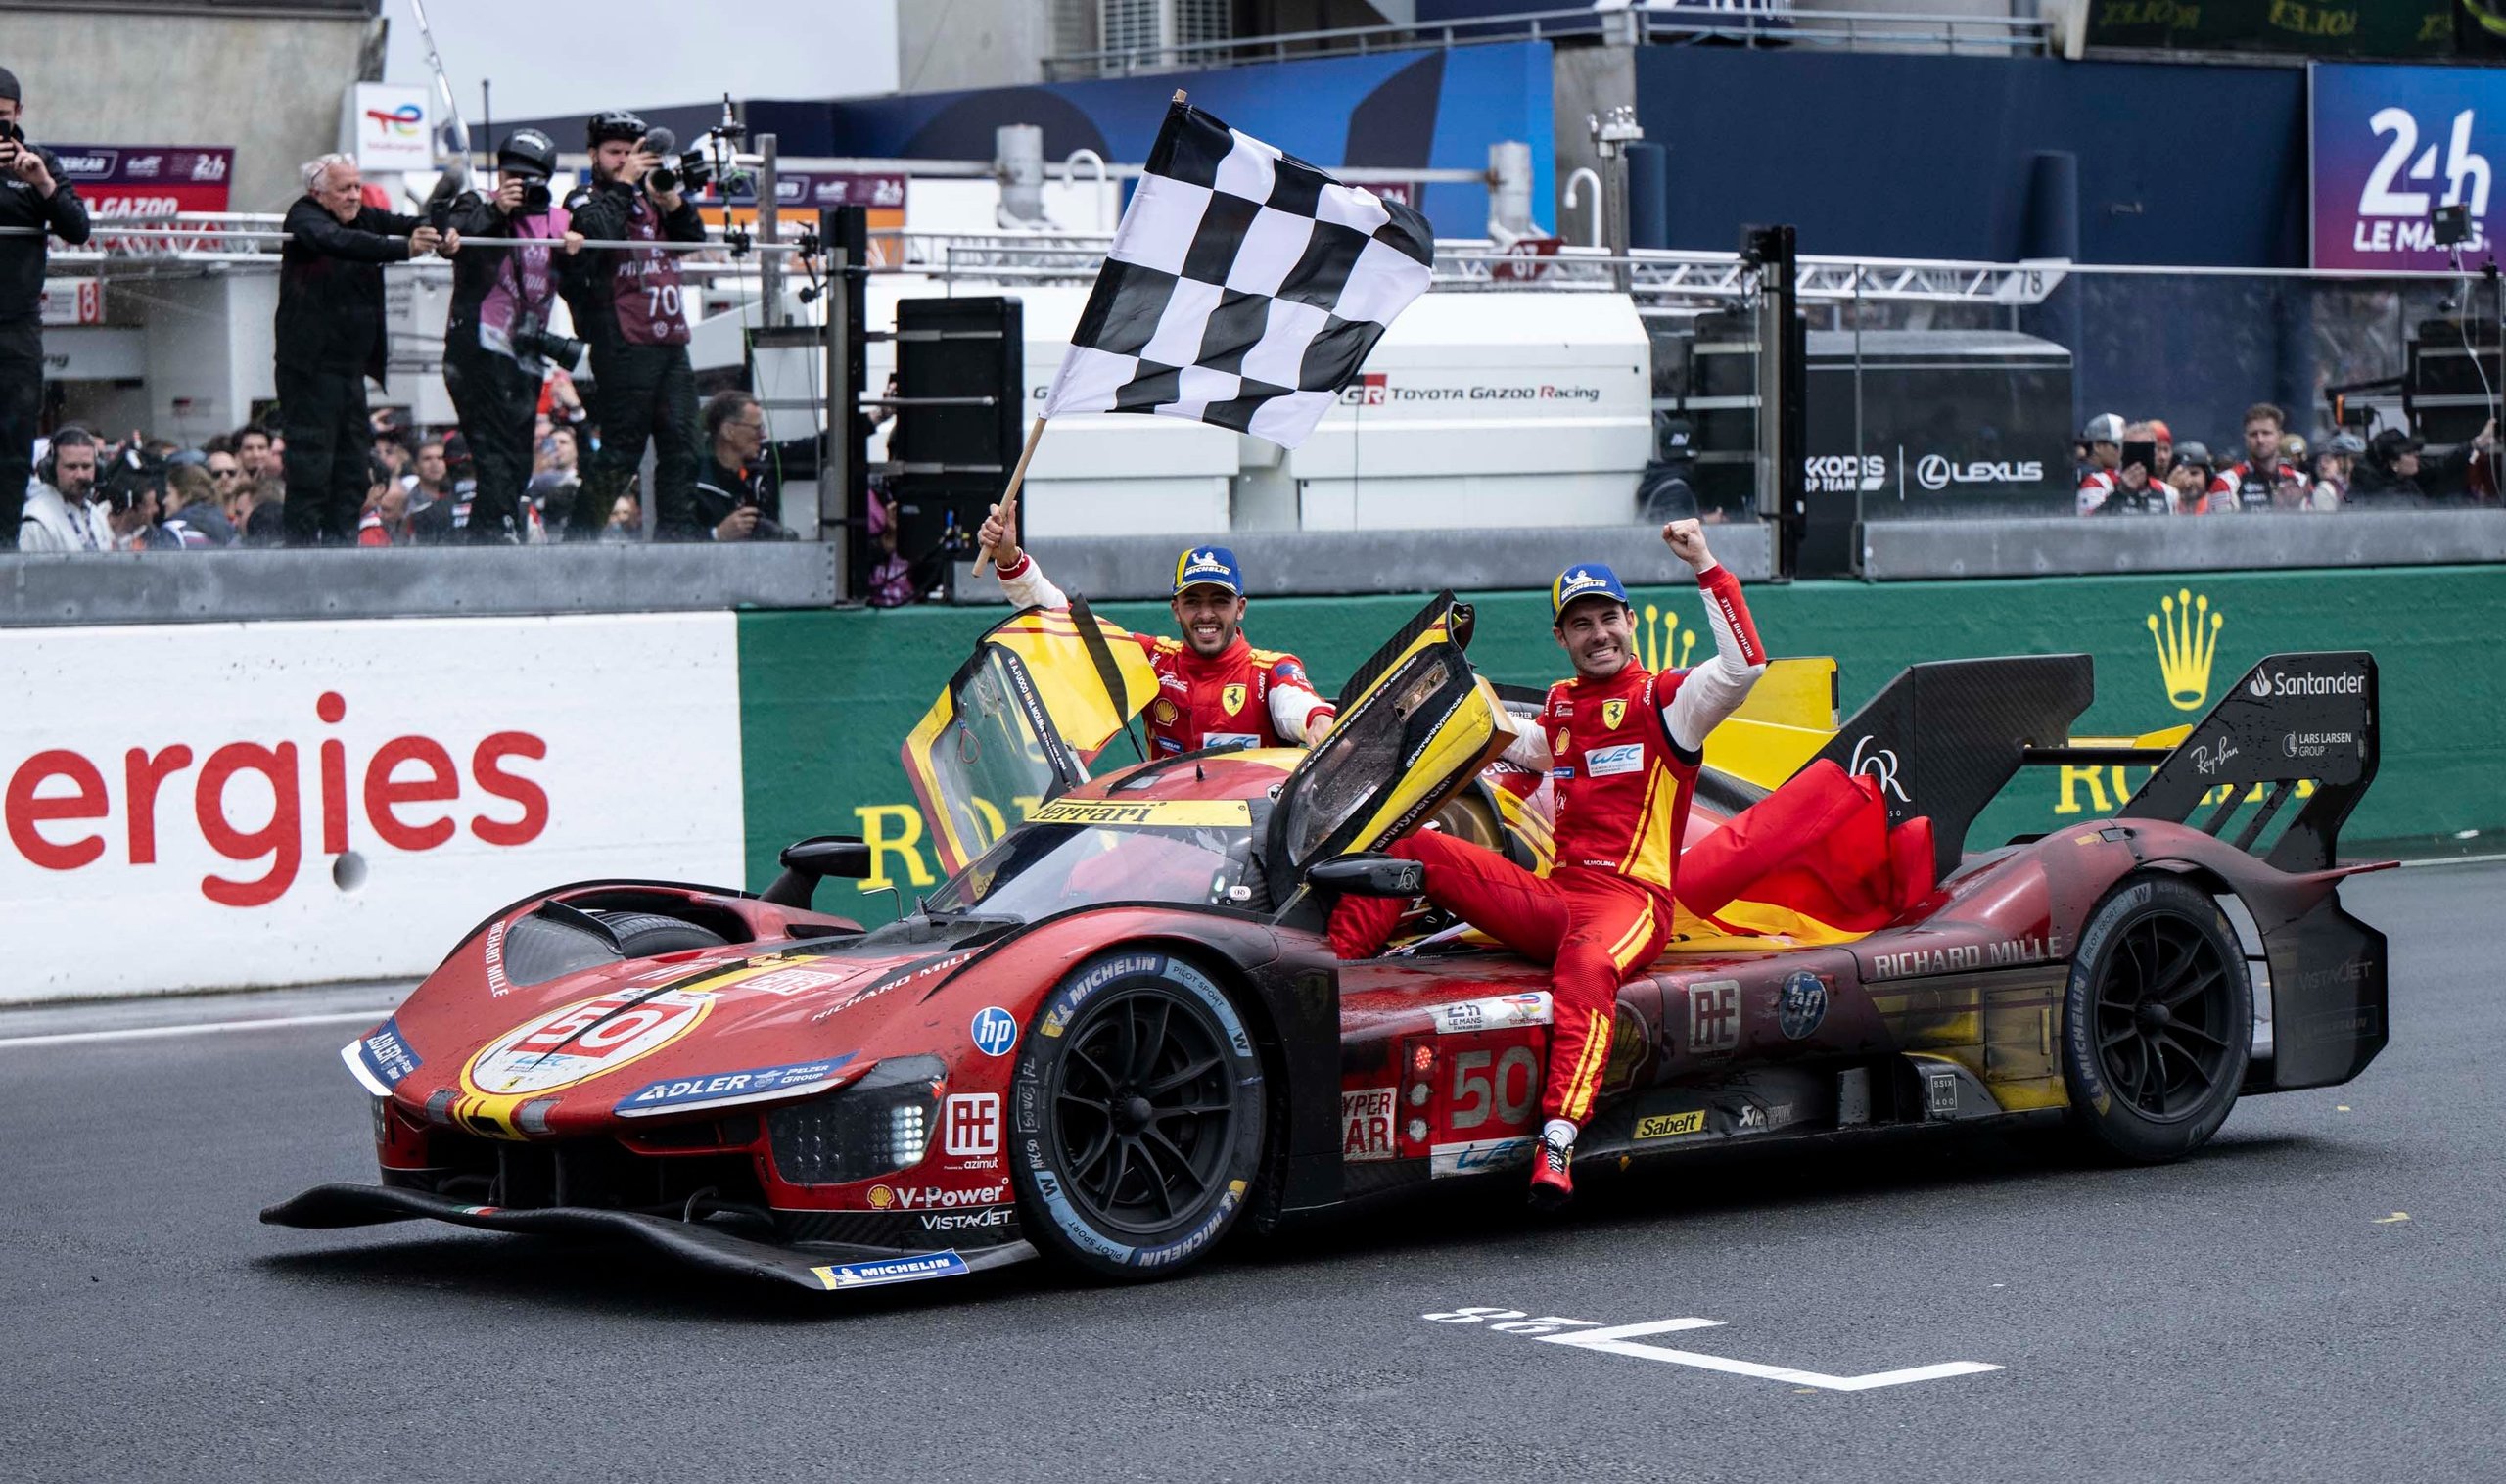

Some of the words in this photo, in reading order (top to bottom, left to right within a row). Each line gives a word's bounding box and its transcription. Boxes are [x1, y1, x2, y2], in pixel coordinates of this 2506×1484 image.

[2359, 107, 2492, 217] 24h
[2353, 221, 2395, 252] LE
[2395, 221, 2485, 252] MAS
[2018, 270, 2044, 294] 78
[1391, 388, 1464, 400] TOYOTA
[1470, 387, 1536, 400] GAZOO
[1540, 385, 1601, 402] Racing
[1952, 461, 2044, 482] LEXUS
[1822, 479, 1856, 491] TEAM
[1183, 566, 1230, 577] MICHELIN
[1560, 579, 1607, 601] MICHELIN
[1720, 597, 1738, 624] MILLE
[1733, 622, 1755, 659] RICHARD
[2275, 672, 2365, 696] Santander
[1406, 692, 1465, 769] @FerrariHypercar
[2299, 733, 2320, 744] LARS
[2321, 732, 2352, 744] LARSEN
[1591, 747, 1641, 765] WEC
[2299, 746, 2324, 757] GROUP
[5, 691, 549, 907] ergies
[1030, 797, 1156, 823] Ferrari
[486, 920, 506, 964] RICHARD
[2084, 932, 2101, 959] PILOT
[1874, 943, 1981, 978] RICHARD
[1988, 935, 2063, 964] MILLE
[487, 962, 509, 998] MILLE
[1069, 956, 1157, 1007] MICHELIN
[1172, 964, 1198, 983] PILOT
[1197, 980, 1226, 1008] SPORT
[811, 975, 912, 1023] RICHARD
[527, 1006, 664, 1048] 50
[979, 1008, 1012, 1054] hp
[1231, 1030, 1250, 1050] W
[2072, 975, 2088, 1080] MICHELIN
[366, 1031, 403, 1065] ADLER
[781, 1073, 823, 1085] GROUP
[785, 1064, 829, 1077] PELZER
[635, 1074, 752, 1102] ADLER
[1452, 1045, 1539, 1130] 50
[1934, 1097, 1955, 1107] 400
[1344, 1117, 1390, 1156] AR
[1640, 1114, 1697, 1136] Sabelt
[964, 1156, 998, 1169] azimut
[897, 1183, 1003, 1209] V-Power
[1040, 1177, 1059, 1199] W
[922, 1206, 1013, 1230] VISTAJET
[1066, 1219, 1098, 1247] SPORT
[1138, 1215, 1224, 1267] MICHELIN
[1095, 1242, 1124, 1261] PILOT
[860, 1257, 950, 1278] MICHELIN
